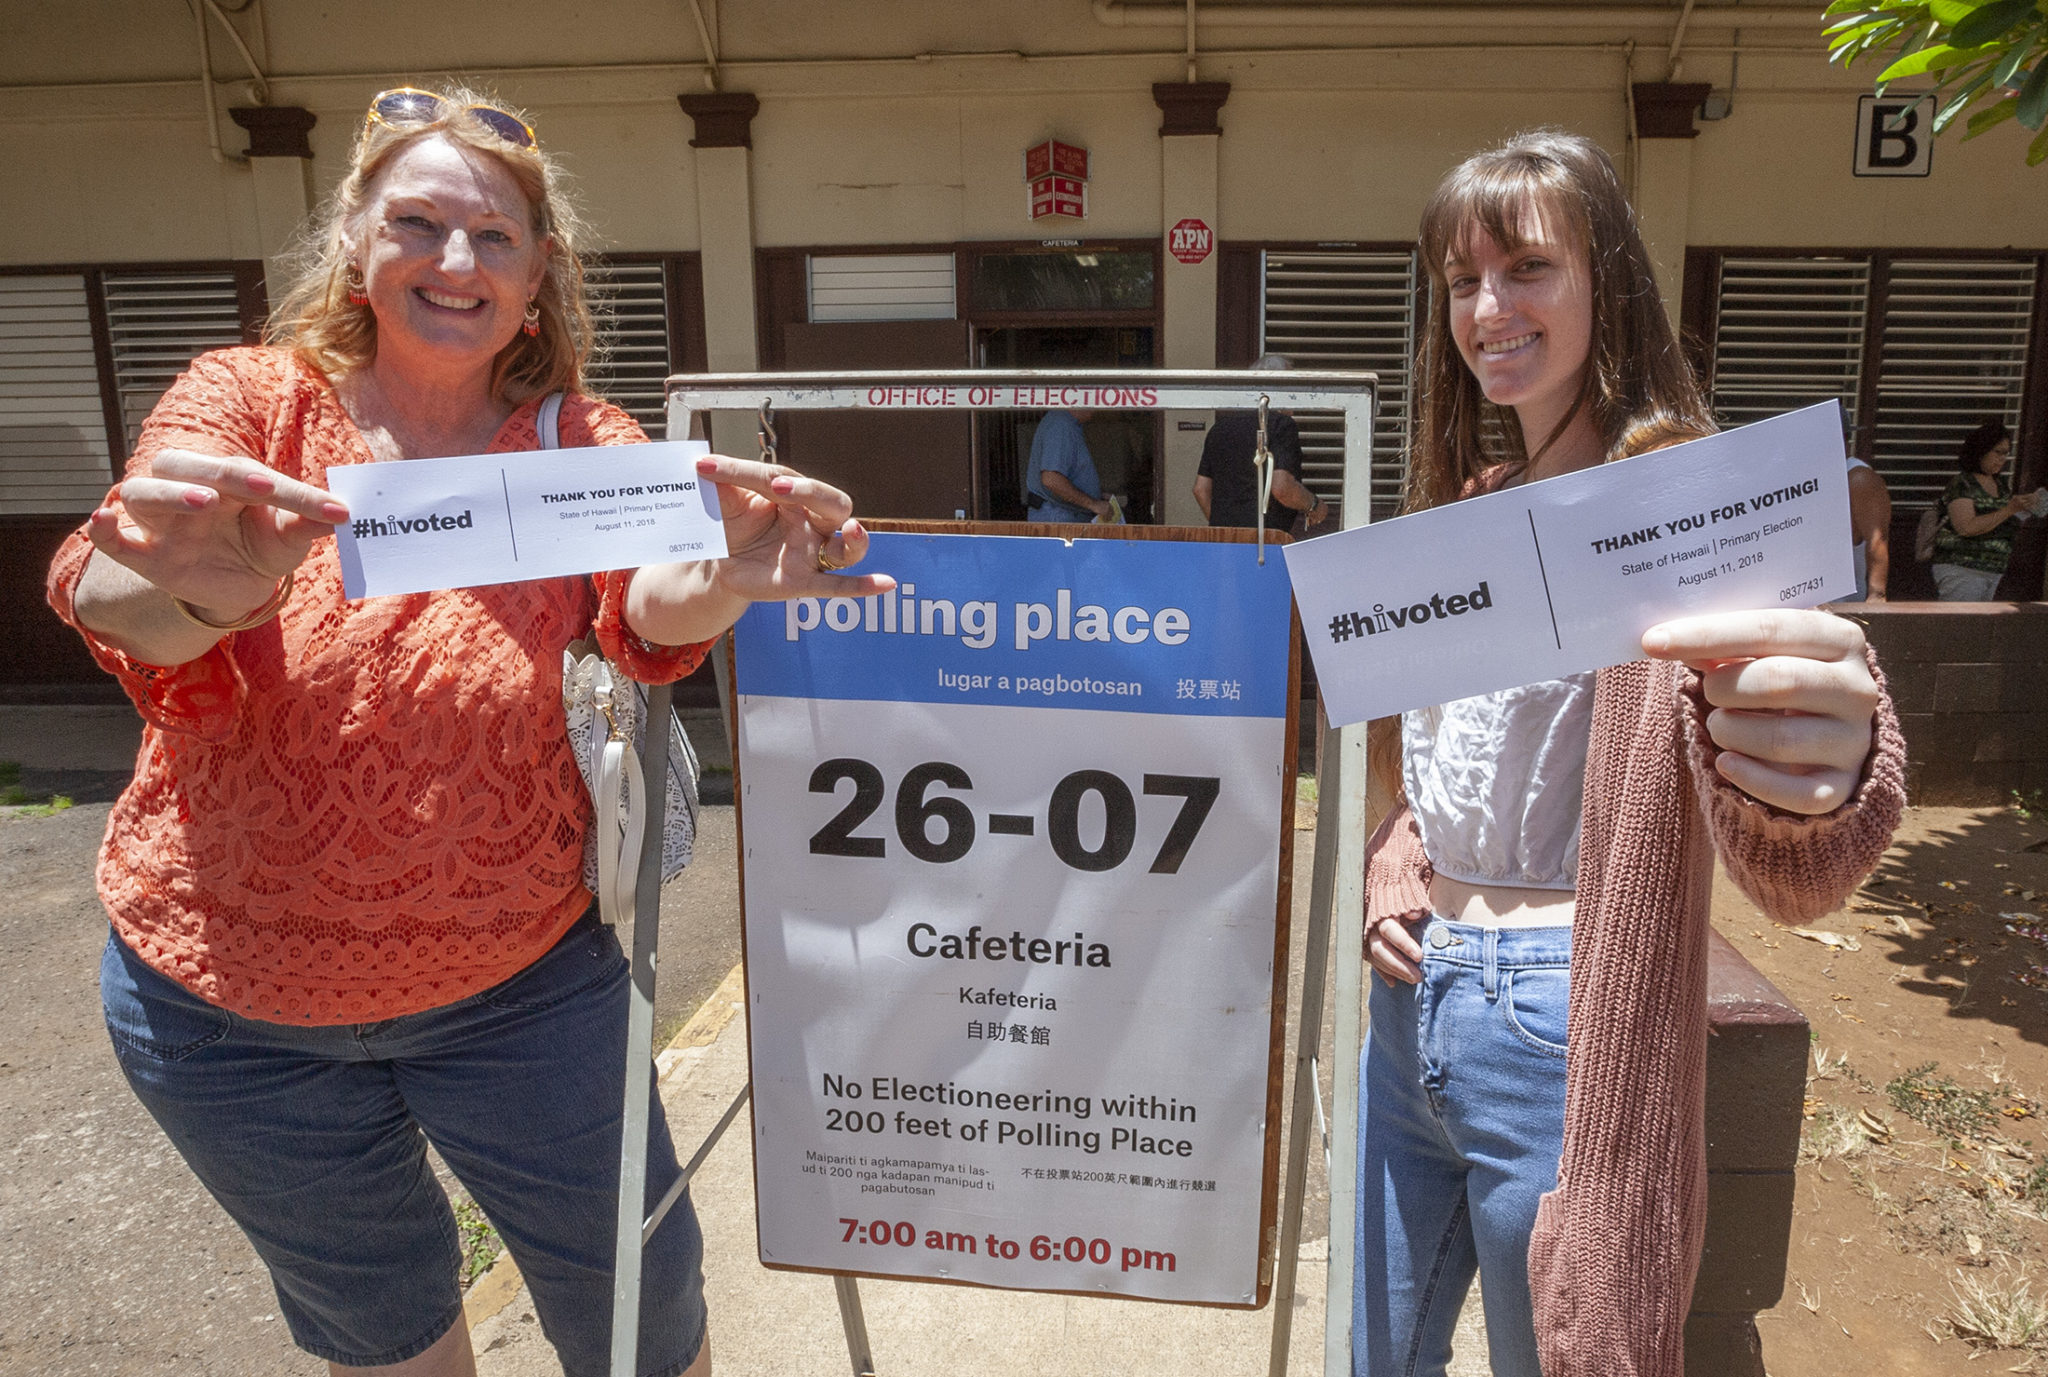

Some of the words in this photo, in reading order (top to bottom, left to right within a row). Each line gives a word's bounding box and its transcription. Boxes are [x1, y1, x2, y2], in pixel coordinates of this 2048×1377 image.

[1868, 105, 1918, 167] B
[1172, 229, 1209, 249] APN
[867, 386, 957, 406] OFFICE
[968, 386, 1002, 406] OF
[1013, 386, 1158, 406] ELECTIONS
[541, 491, 587, 504] THANK
[589, 488, 616, 499] YOU
[619, 486, 644, 497] FOR
[645, 481, 696, 494] VOTING!
[559, 511, 580, 520] State
[581, 509, 590, 518] of
[591, 507, 618, 517] Hawaii
[623, 503, 653, 513] Primary
[655, 501, 685, 511] Election
[1591, 525, 1663, 554] THANK
[1664, 513, 1705, 536] YOU
[1710, 501, 1748, 524] FOR
[1749, 478, 1819, 512] VOTING!
[352, 510, 473, 539] #hivoted
[594, 521, 622, 532] August
[624, 520, 635, 529] 11,
[636, 518, 656, 527] 2018
[668, 541, 704, 553] 08377430
[1621, 560, 1653, 576] State
[1656, 554, 1668, 568] of
[1671, 545, 1711, 564] Hawaii
[1719, 528, 1761, 550] Primary
[1763, 515, 1804, 537] Election
[1677, 566, 1718, 587] August
[1720, 561, 1736, 574] 11,
[1738, 551, 1764, 569] 2018
[1779, 576, 1825, 602] 08377431
[785, 583, 998, 650] polling
[1014, 589, 1191, 651] place
[1328, 581, 1493, 644] #hivoted
[938, 668, 992, 692] lugar
[997, 675, 1010, 690] a
[1015, 673, 1142, 696] pagbotosan
[1175, 678, 1242, 700] 投票站
[807, 757, 1221, 875] 26-07
[906, 922, 1113, 968] Cafeteria
[959, 986, 1058, 1011] Kafeteria
[967, 1020, 1051, 1046] 自助餐館
[822, 1073, 863, 1100] No
[872, 1077, 1092, 1120] Electioneering
[1101, 1094, 1198, 1123] within
[825, 1108, 886, 1134] 200
[894, 1111, 951, 1139] feet
[959, 1118, 989, 1144] of
[997, 1121, 1102, 1155] Polling
[1110, 1128, 1194, 1158] Place
[806, 1150, 857, 1165] Maipariti
[859, 1156, 868, 1166] ti
[871, 1156, 955, 1173] agkamapamya
[958, 1163, 966, 1174] ti
[969, 1164, 990, 1176] las-
[802, 1164, 816, 1174] ud
[819, 1165, 827, 1175] ti
[829, 1166, 853, 1178] 200
[856, 1169, 878, 1181] nga
[881, 1169, 931, 1185] kadapan
[933, 1175, 984, 1190] manipud
[986, 1180, 995, 1191] ti
[860, 1181, 936, 1196] pagabutosan
[838, 1217, 916, 1246] 7:00
[925, 1227, 977, 1254] am
[985, 1232, 1021, 1260] to
[1029, 1235, 1112, 1266] 6:00
[1121, 1247, 1177, 1272] pm
